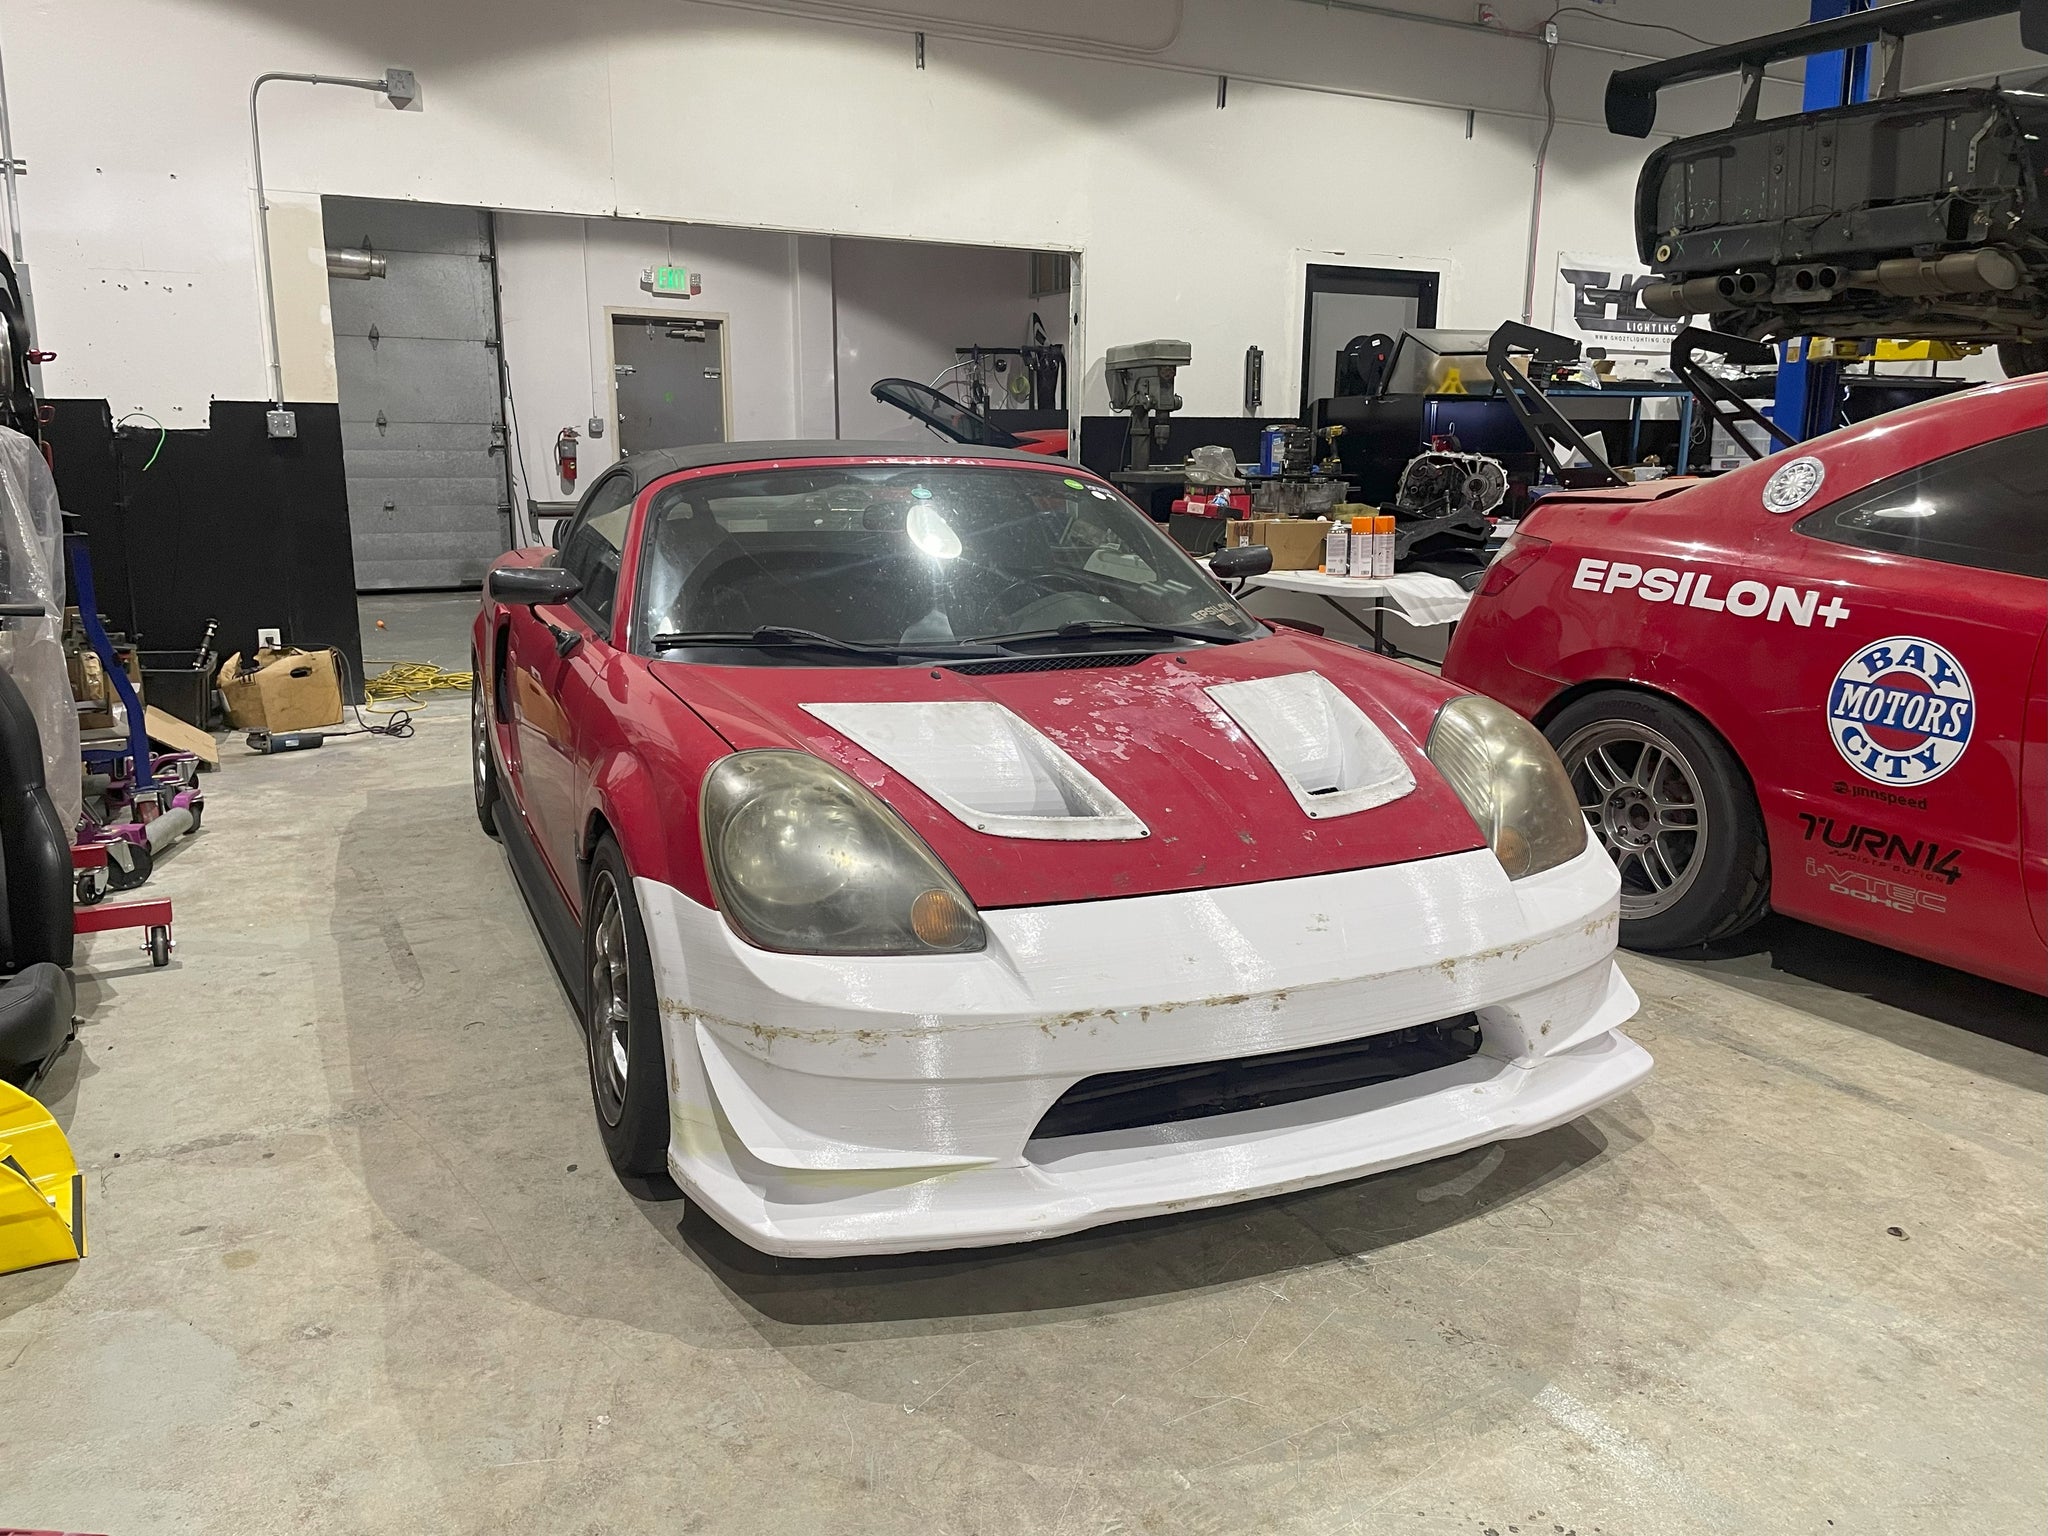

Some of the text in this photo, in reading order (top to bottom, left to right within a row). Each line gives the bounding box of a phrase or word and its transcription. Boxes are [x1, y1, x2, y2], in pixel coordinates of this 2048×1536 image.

[658, 267, 685, 290] EXIT
[1626, 321, 1678, 333] LIGHTING
[1572, 557, 1850, 628] EPSILON+
[1857, 643, 1961, 689] BAY
[1834, 683, 1969, 738] MOTORS
[1841, 726, 1942, 778] CITY
[1798, 812, 1963, 885] TURN14
[1829, 883, 1914, 914] DOHC
